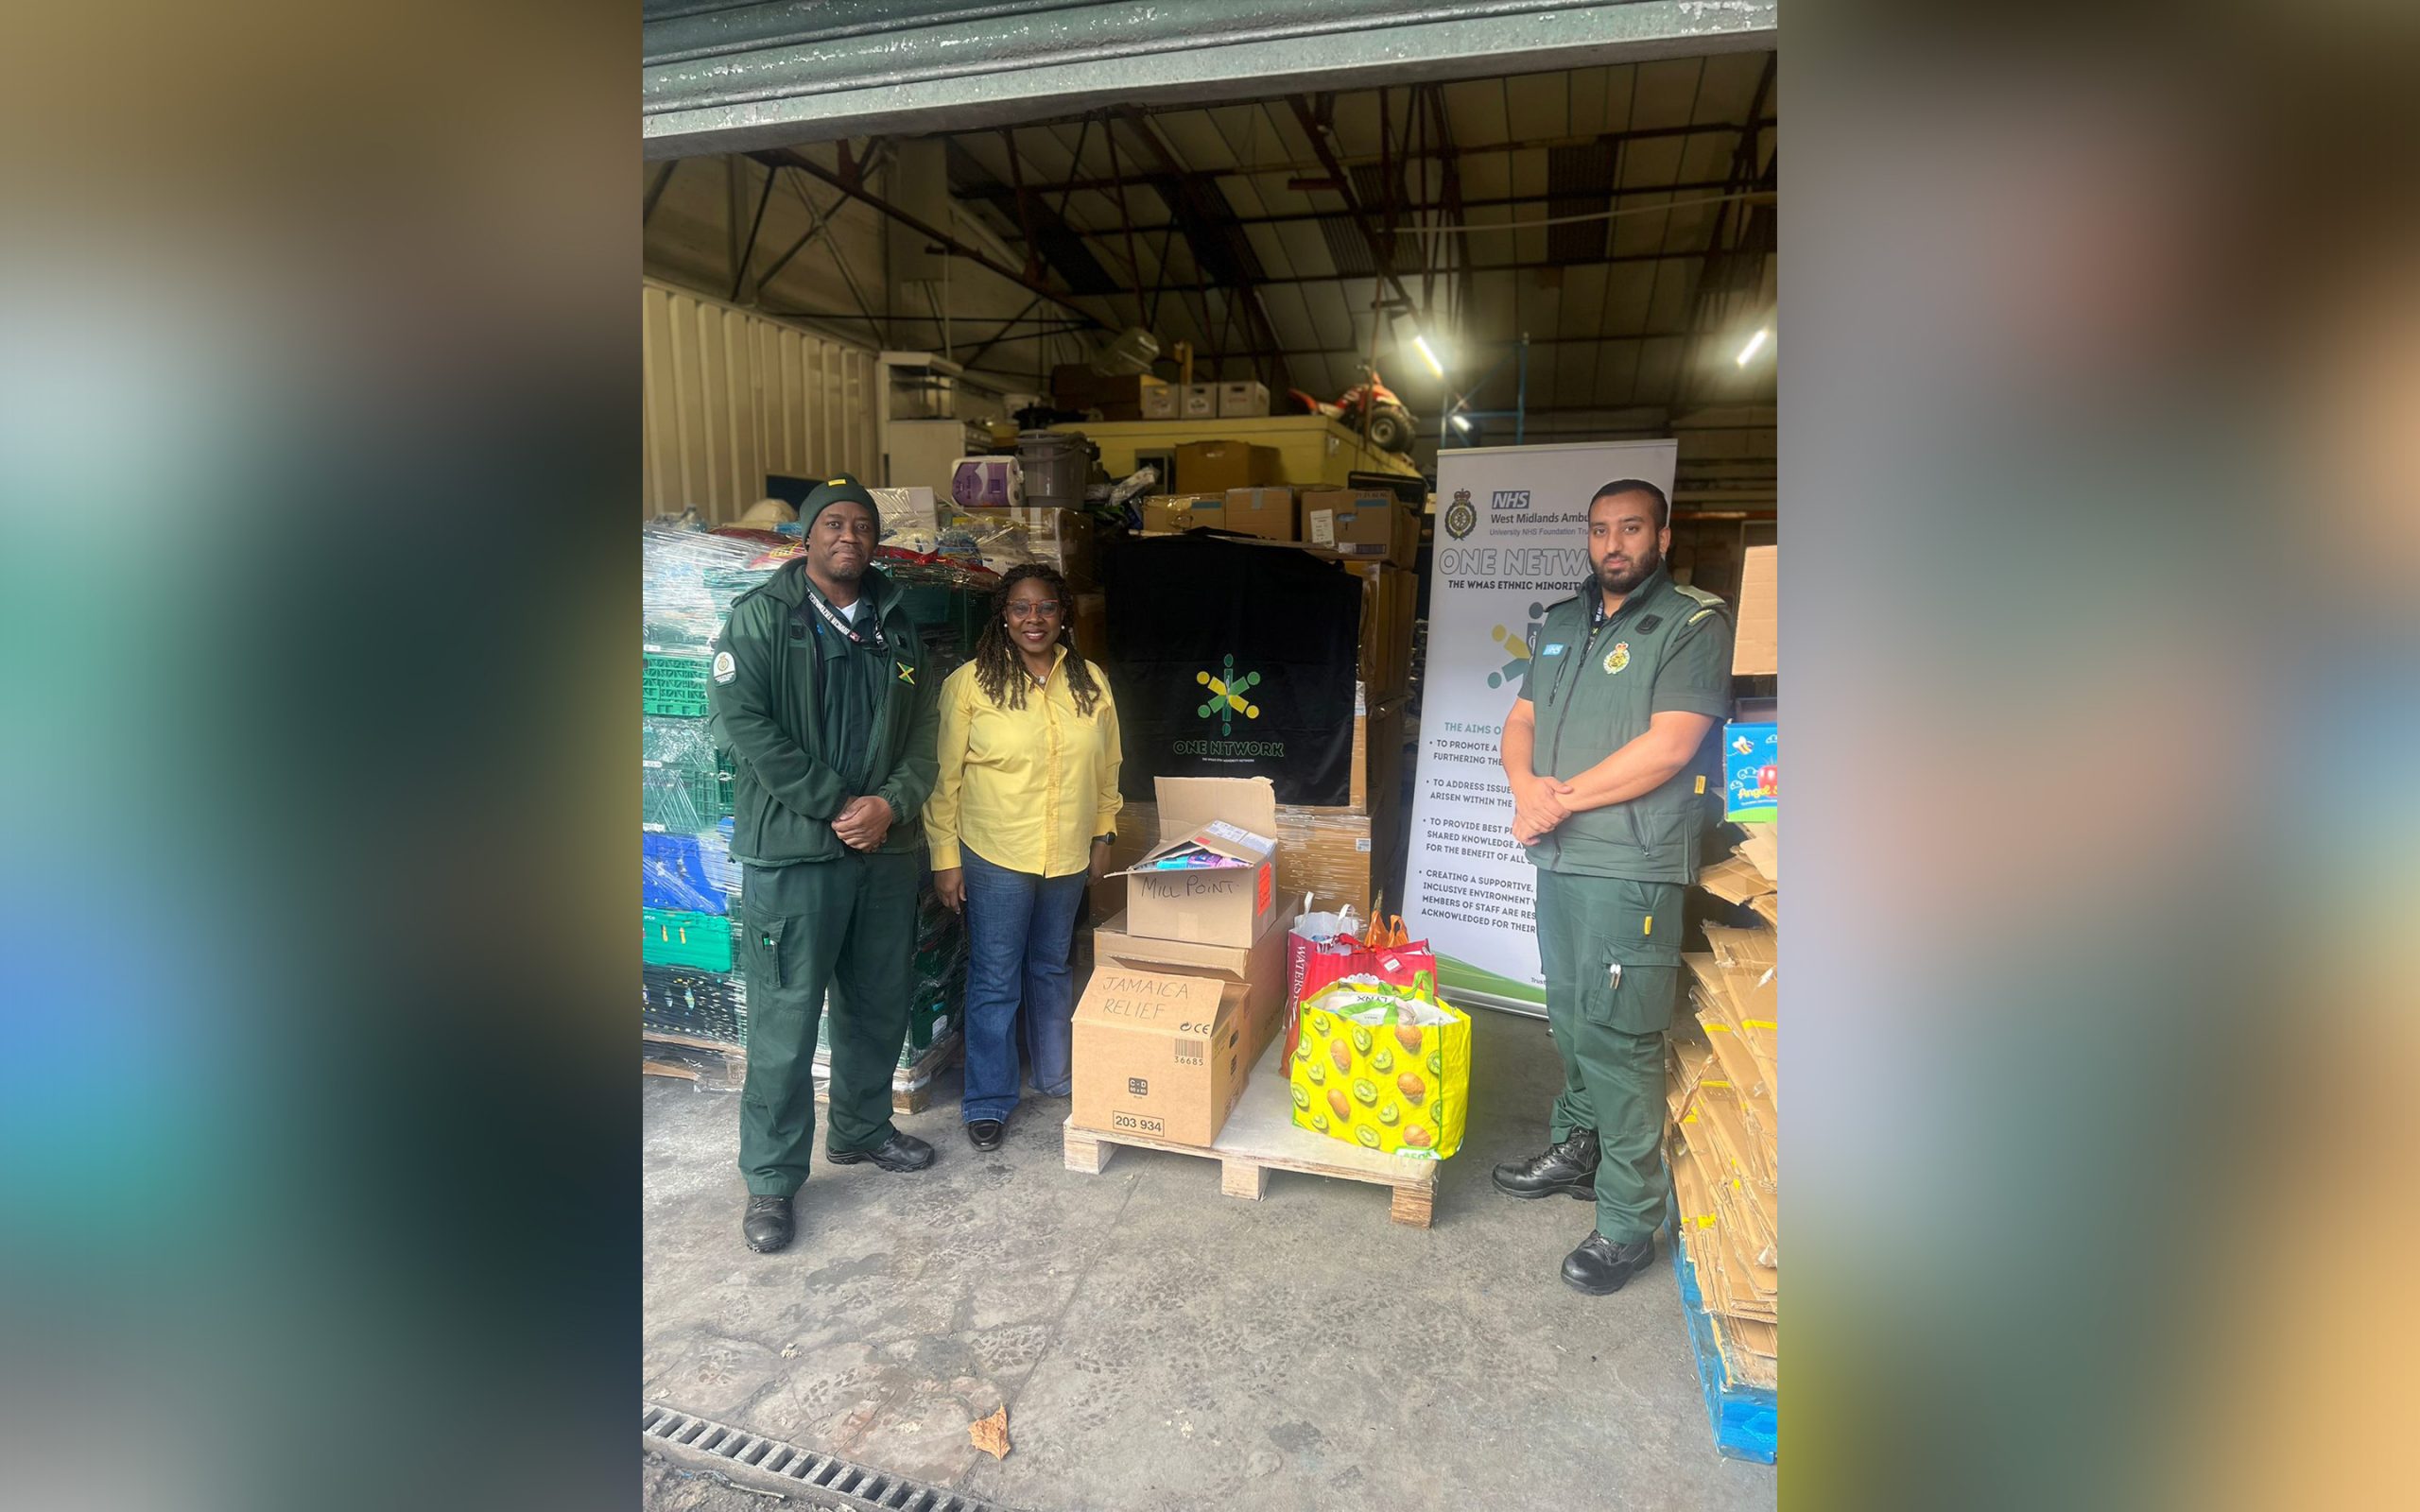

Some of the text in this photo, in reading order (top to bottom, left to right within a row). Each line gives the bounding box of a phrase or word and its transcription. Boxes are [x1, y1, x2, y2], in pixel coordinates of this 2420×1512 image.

[1494, 492, 1529, 507] NHS
[1491, 514, 1513, 523] West
[1516, 512, 1559, 523] Midlands
[1440, 548, 1594, 576] ONE NETW
[1467, 581, 1495, 590] WMAS
[1498, 581, 1532, 590] ETHNIC
[1444, 722, 1502, 735] THE AIMS O
[1173, 740, 1285, 757] ONE NTWORK
[1449, 741, 1489, 751] PROMOTE
[1433, 752, 1485, 765] FURTHERING
[1446, 781, 1484, 791] ADDRESS
[1487, 784, 1513, 794] ISSUE
[1430, 792, 1512, 807] ARISEN WITHIN THE
[1443, 819, 1480, 831] PROVIDE
[1482, 824, 1502, 833] BEST
[1427, 830, 1460, 841] SHARED
[1461, 834, 1513, 849] KNOWLEDGE
[1426, 843, 1442, 852] FOR
[1444, 846, 1460, 854] THE
[1461, 848, 1495, 859] BENEFIT
[1497, 852, 1508, 861] OF
[1510, 854, 1525, 864] ALL
[1426, 869, 1468, 882] CREATING
[1424, 882, 1467, 895] INCLUSIVE
[1469, 888, 1530, 904] ENVIRONMENT
[1423, 895, 1461, 907] MEMBERS
[1462, 901, 1473, 909] OF
[1475, 902, 1500, 913] STAFF
[1502, 908, 1518, 917] ARE
[1422, 908, 1535, 933] ACKNOWLEDGED FOR THEIR
[1102, 976, 1189, 999] JAMAICA
[1103, 998, 1166, 1020] RELIEF
[1174, 1056, 1203, 1066] 36685
[1115, 1115, 1162, 1132] 203 934
